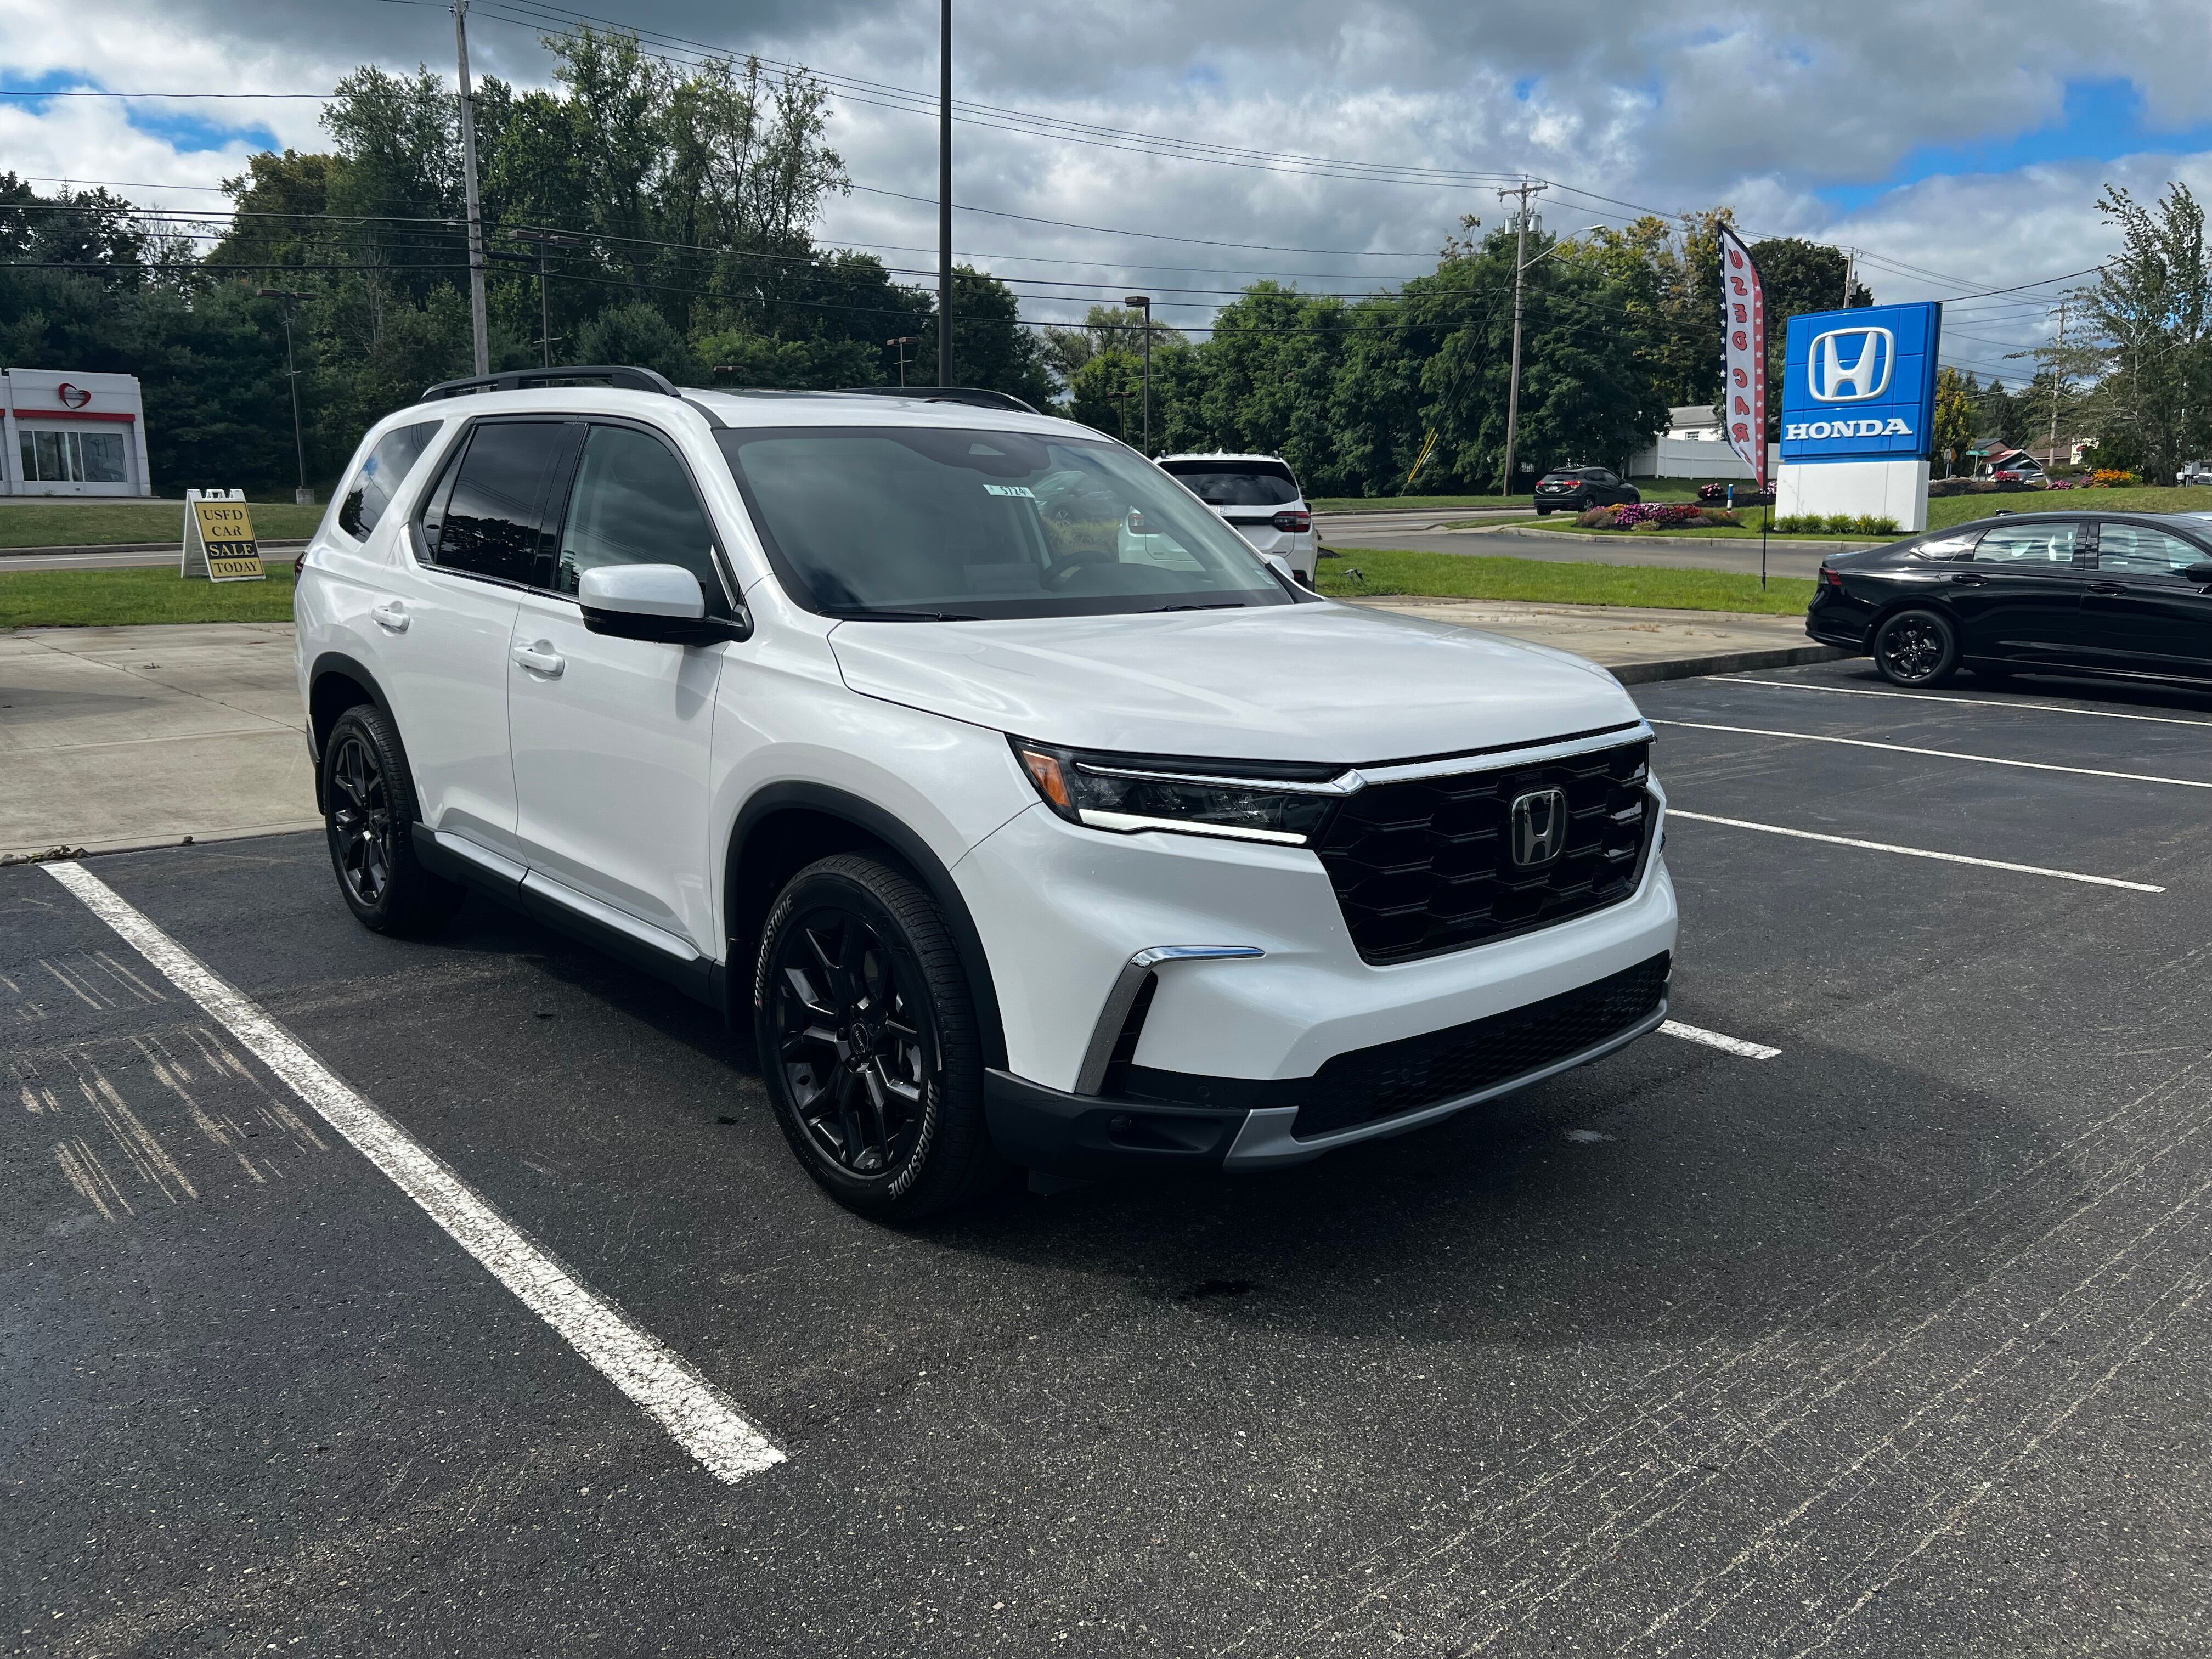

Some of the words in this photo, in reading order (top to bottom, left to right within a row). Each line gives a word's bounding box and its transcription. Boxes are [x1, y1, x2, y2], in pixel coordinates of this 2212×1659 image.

[1785, 418, 1913, 440] HONDA
[999, 486, 1026, 496] 5724
[212, 526, 243, 537] CAR
[209, 543, 255, 556] SALE
[213, 561, 257, 573] TODAY
[754, 894, 794, 1012] BRIDGESTONE
[887, 1078, 941, 1201] BRIDGESTONE
